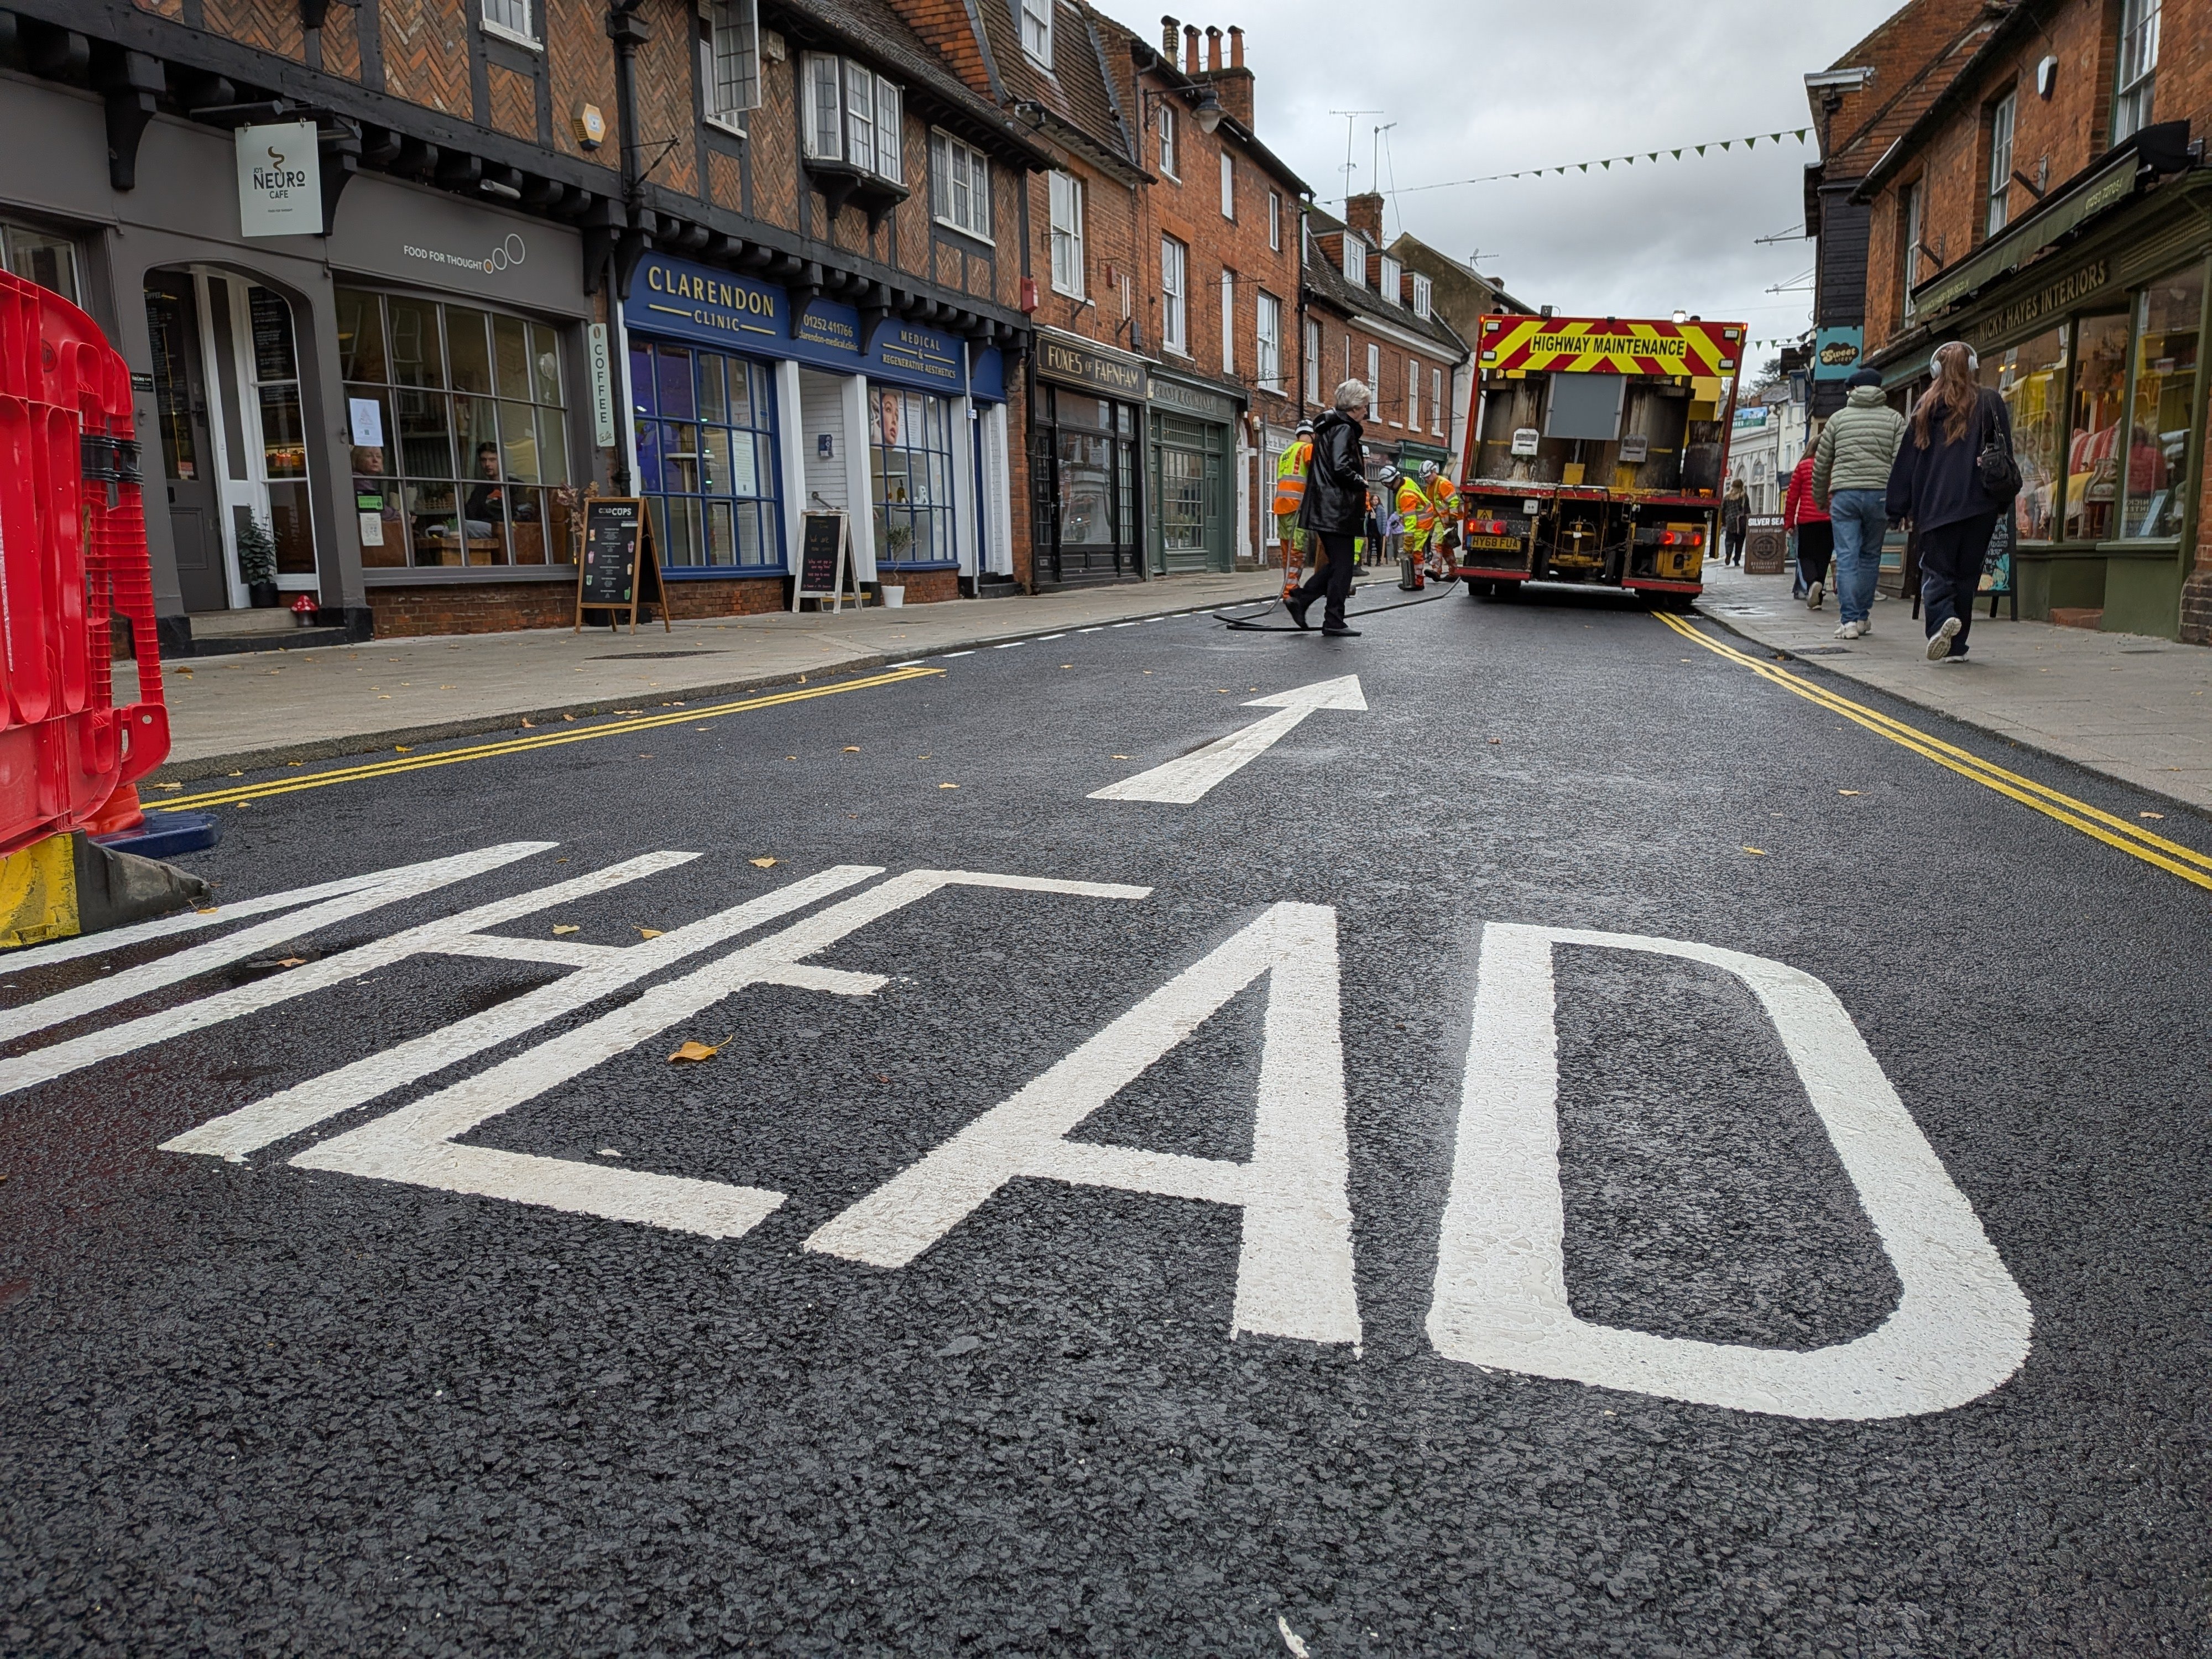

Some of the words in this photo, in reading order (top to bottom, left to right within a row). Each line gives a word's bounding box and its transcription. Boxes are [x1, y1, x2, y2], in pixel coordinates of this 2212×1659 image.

[253, 171, 305, 190] NEURO
[269, 190, 289, 199] CAFE
[404, 245, 427, 259] FOOD
[429, 251, 445, 263] FOR
[446, 254, 482, 270] THOUGHT
[648, 265, 774, 317] CLARENDON
[1979, 311, 2004, 342] NICKY
[2006, 295, 2037, 330] HAYES
[2041, 260, 2106, 314] INTERIORS
[694, 310, 739, 331] CLINIC
[804, 314, 827, 331] 01252
[827, 322, 853, 338] 411766
[901, 330, 940, 351] MEDICAL
[1532, 335, 1591, 353] HIGHWAY
[1593, 338, 1686, 356] MAINTENANCE
[917, 348, 924, 359] &
[883, 354, 924, 372] REGENERATIVE
[925, 364, 956, 379] AESTHETICS
[1048, 345, 1083, 374] FOXES
[1085, 361, 1093, 372] OF
[1094, 359, 1139, 389] FARNHAM
[594, 344, 607, 423] COFFEE
[1748, 518, 1770, 526] SILVER
[1472, 536, 1498, 547] HY68
[1499, 538, 1518, 548] FUA
